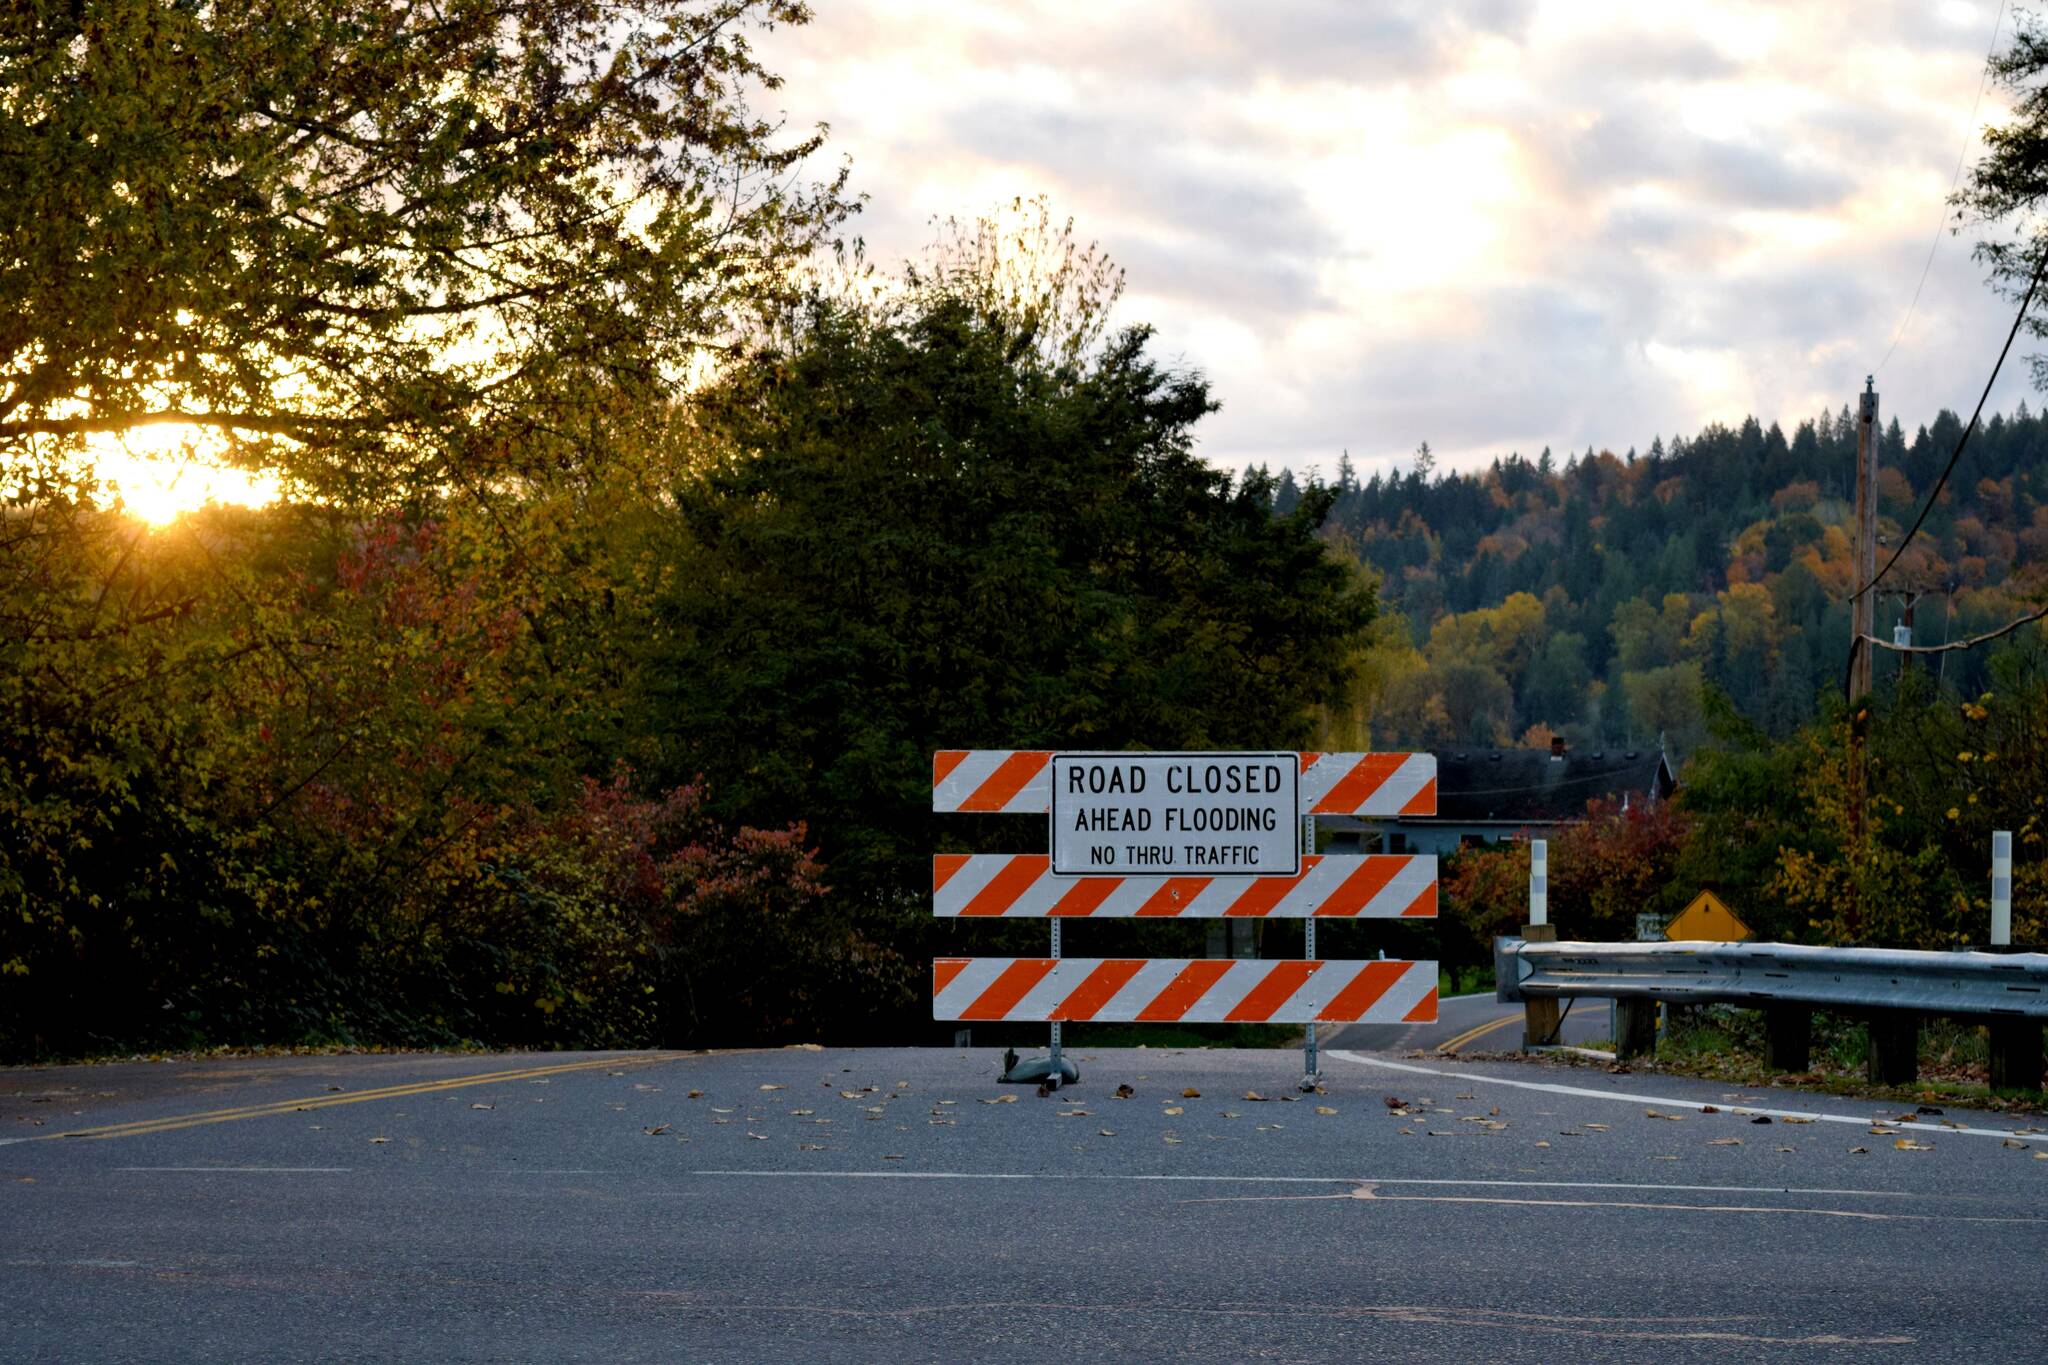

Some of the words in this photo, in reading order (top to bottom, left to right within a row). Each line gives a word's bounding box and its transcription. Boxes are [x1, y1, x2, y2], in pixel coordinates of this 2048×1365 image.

[1068, 765, 1146, 794] ROAD
[1166, 764, 1282, 794] CLOSED
[1074, 807, 1152, 832] AHEAD
[1165, 807, 1277, 832] FLOODING
[1090, 845, 1116, 865] NO
[1125, 845, 1174, 865] THRU
[1183, 845, 1260, 865] TRAFFIC
